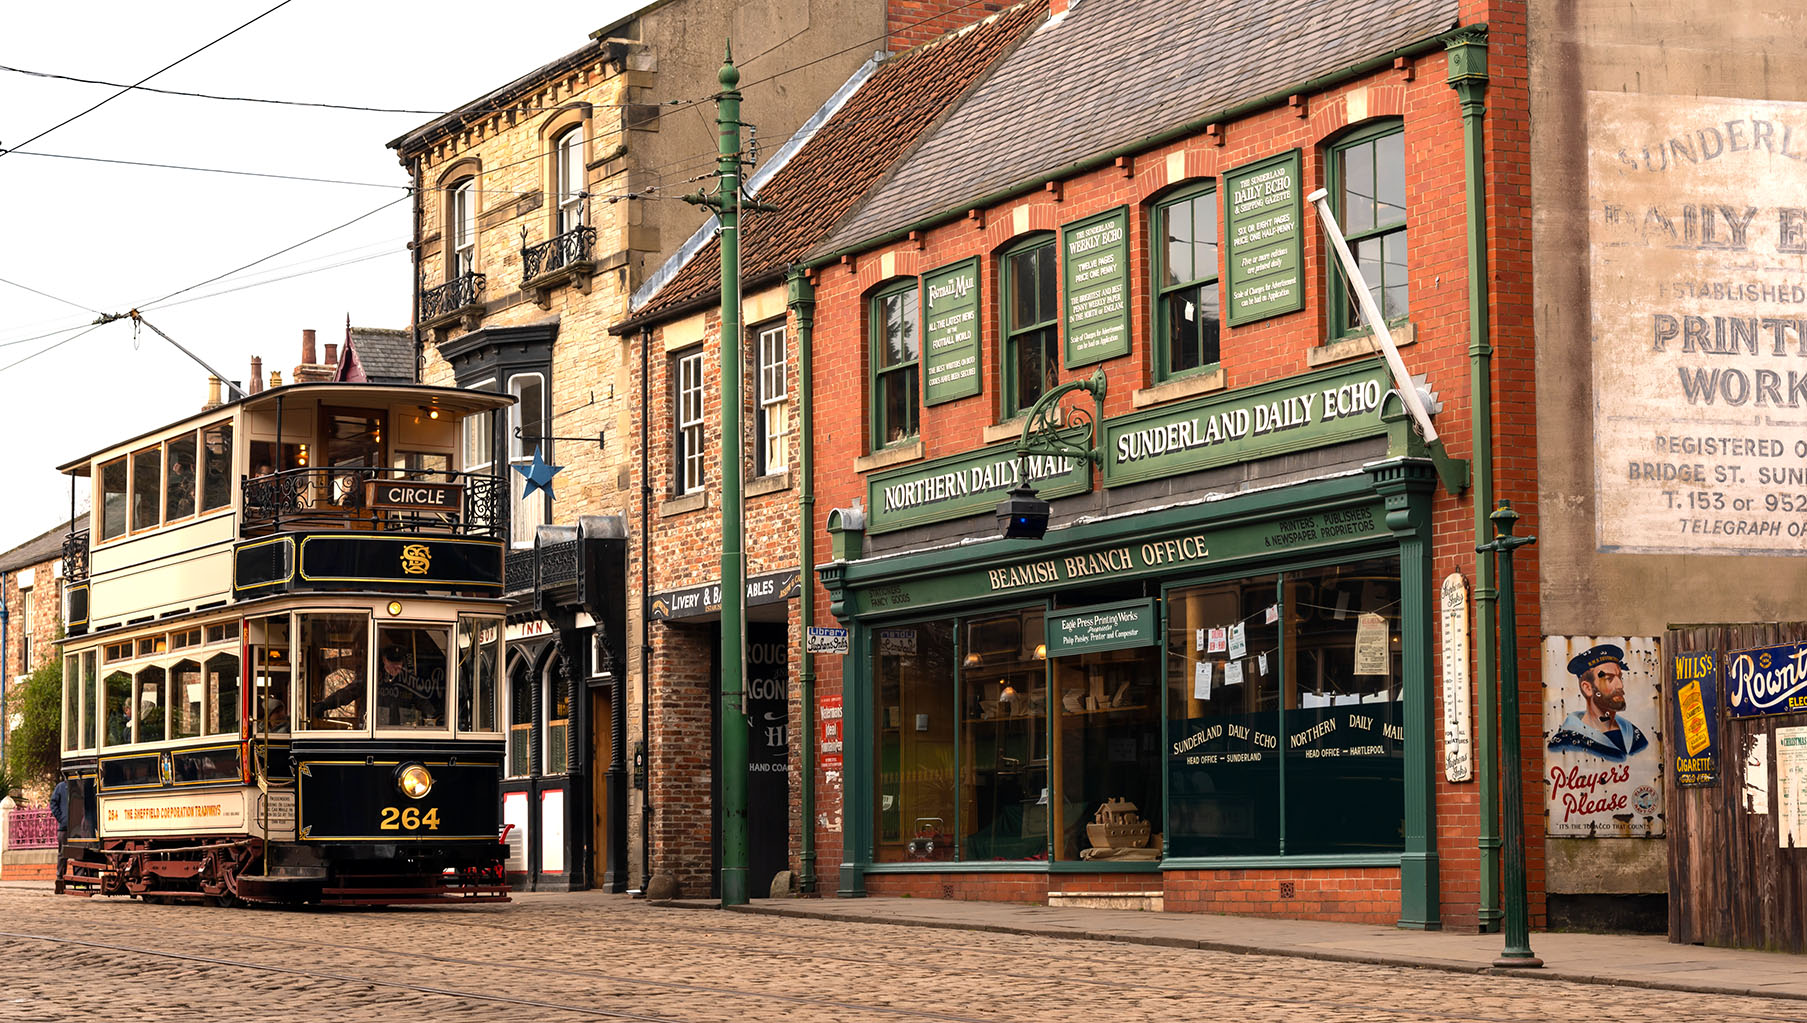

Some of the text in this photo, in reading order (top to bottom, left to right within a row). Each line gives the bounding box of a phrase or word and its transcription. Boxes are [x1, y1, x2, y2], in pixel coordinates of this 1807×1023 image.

[1240, 168, 1285, 188] THE SUNDERLAND
[1234, 176, 1290, 205] DAILY ECHO
[1234, 191, 1291, 215] & SHIPPING GAZETTE
[1238, 214, 1290, 236] SIX OR EIGHT PAGES
[1069, 228, 1123, 255] WEEKLY ECHO
[1233, 236, 1249, 247] PRICE
[1249, 232, 1261, 242] ONE
[1075, 263, 1117, 283] PRICE ONE PENNY
[1078, 254, 1114, 272] TWELVE PAGES
[928, 275, 975, 308] FOOTBALL MAIL
[929, 322, 937, 332] ALL
[937, 319, 946, 329] THE
[945, 314, 962, 326] LATEST
[933, 335, 955, 349] FOOTBALL
[1117, 379, 1381, 463] SUNDERLAND DAILY ECHO
[1655, 435, 1785, 458] REGISTERED
[883, 448, 1074, 512] NORTHERN DAILY MAIL
[1629, 462, 1707, 482] BRIDGE
[1714, 465, 1745, 484] ST.
[388, 487, 446, 505] CIRCLE
[1733, 498, 1754, 511] or
[1323, 507, 1372, 526] PUBLISHERS
[1264, 520, 1375, 548] & NEWSPAPER PROPRIETORS
[1679, 519, 1782, 537] TELEGRAPH
[988, 535, 1209, 590] BEAMISH BRANCH OFFICE
[671, 593, 700, 611] LIVERY
[703, 587, 712, 605] &
[891, 593, 911, 604] GOODS
[479, 622, 543, 643] SUN INN
[810, 628, 845, 637] Library
[1061, 611, 1139, 633] Eagle Press Printing Works
[1090, 632, 1106, 641] Printer
[1106, 631, 1114, 640] and
[1173, 724, 1277, 755] SUNDERLAND DAILY ECHO
[1290, 714, 1404, 748] NORTHERN DAILY MAIL
[1186, 752, 1262, 765] HEAD OFFICE SUNDERLAND
[1305, 745, 1384, 758] HEAD OFFICE HARTLEPOOL
[749, 763, 770, 772] HAND
[1551, 764, 1630, 800] Player's
[124, 809, 133, 820] THE
[134, 807, 160, 820] SHEFFIELD
[160, 805, 195, 819] CORPORATION
[380, 806, 440, 830] 264
[1563, 792, 1628, 823] Please
